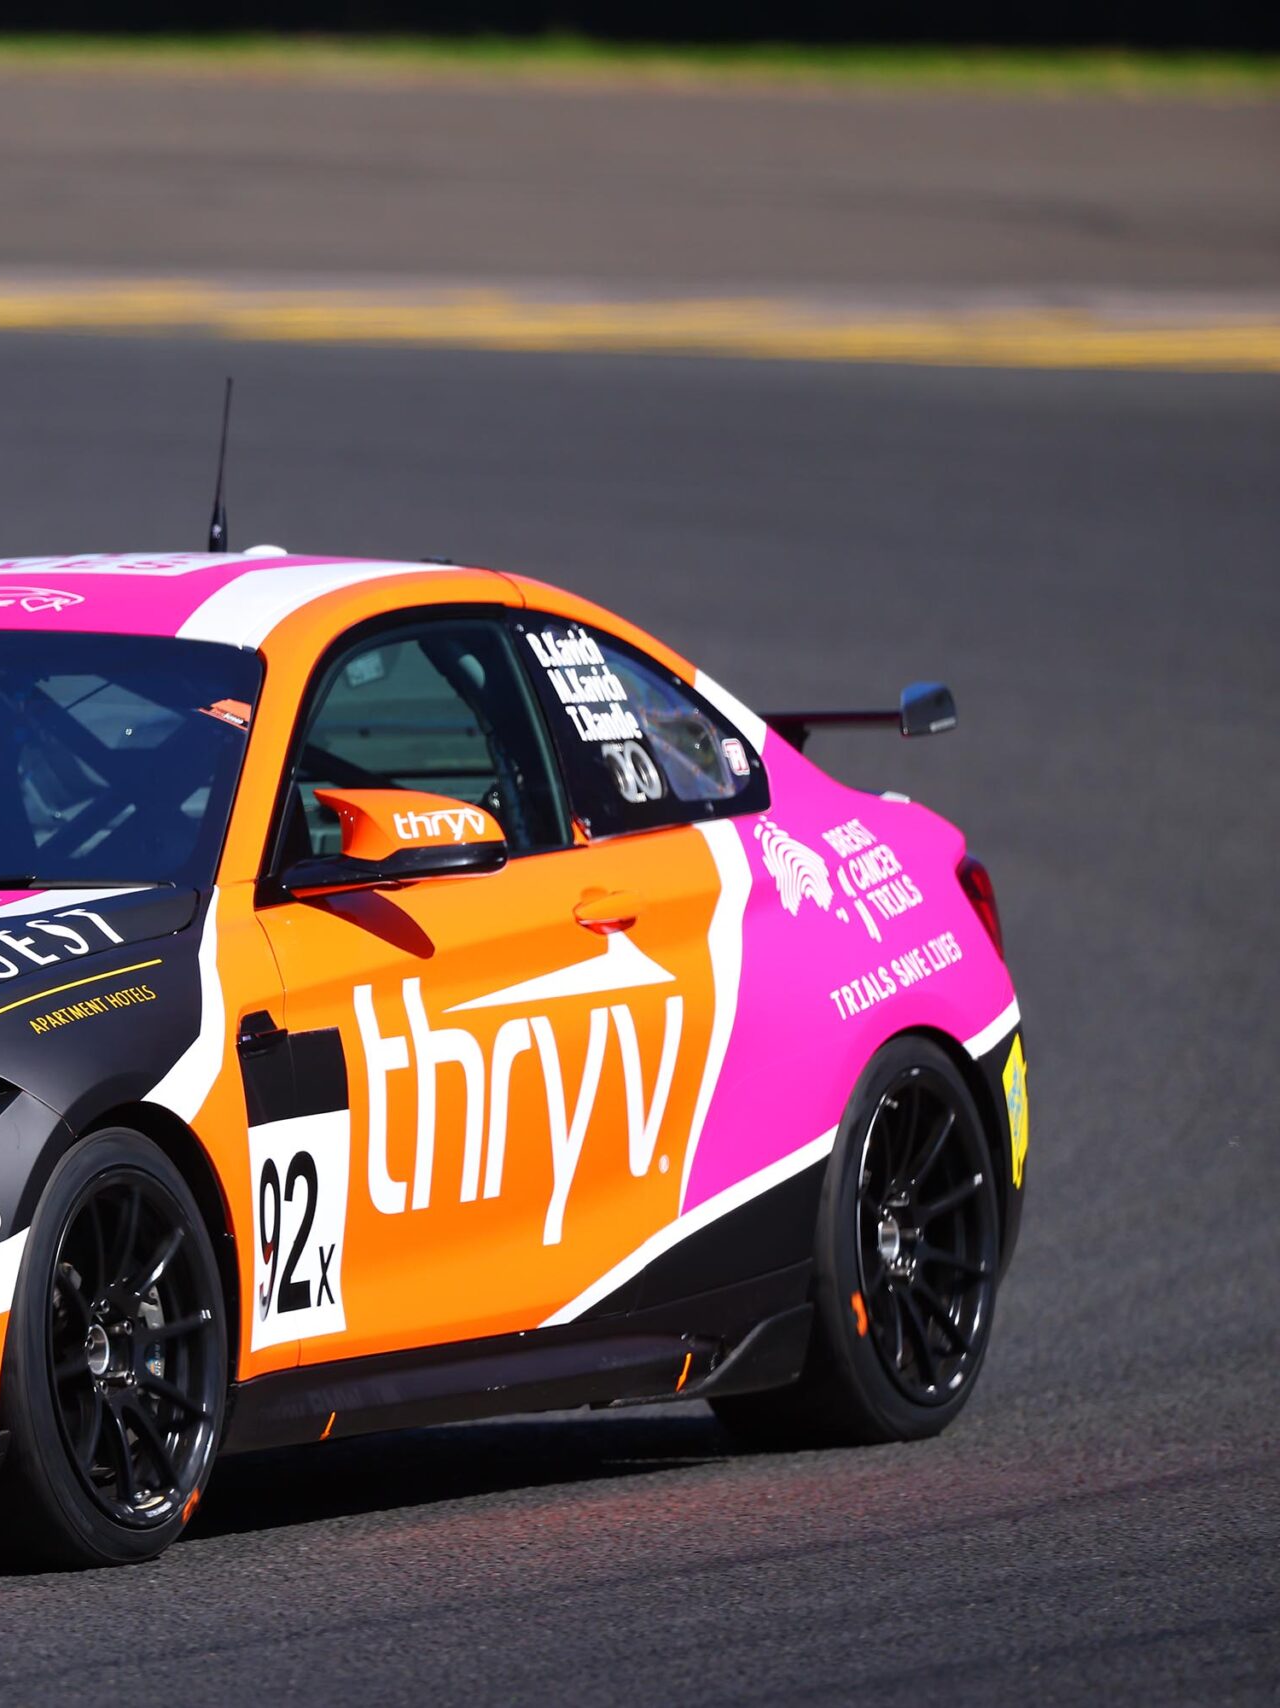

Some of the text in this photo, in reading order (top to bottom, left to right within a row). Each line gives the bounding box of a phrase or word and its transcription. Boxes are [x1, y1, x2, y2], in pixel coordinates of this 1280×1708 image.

[393, 809, 485, 840] thryv
[821, 818, 877, 858] BREAST
[848, 844, 903, 891] CANCER
[866, 874, 924, 920] TRIALS
[830, 931, 963, 1020] TRIALS SAVE LIVES
[29, 984, 157, 1035] APARTMENT HOTELS
[353, 977, 684, 1245] thryv
